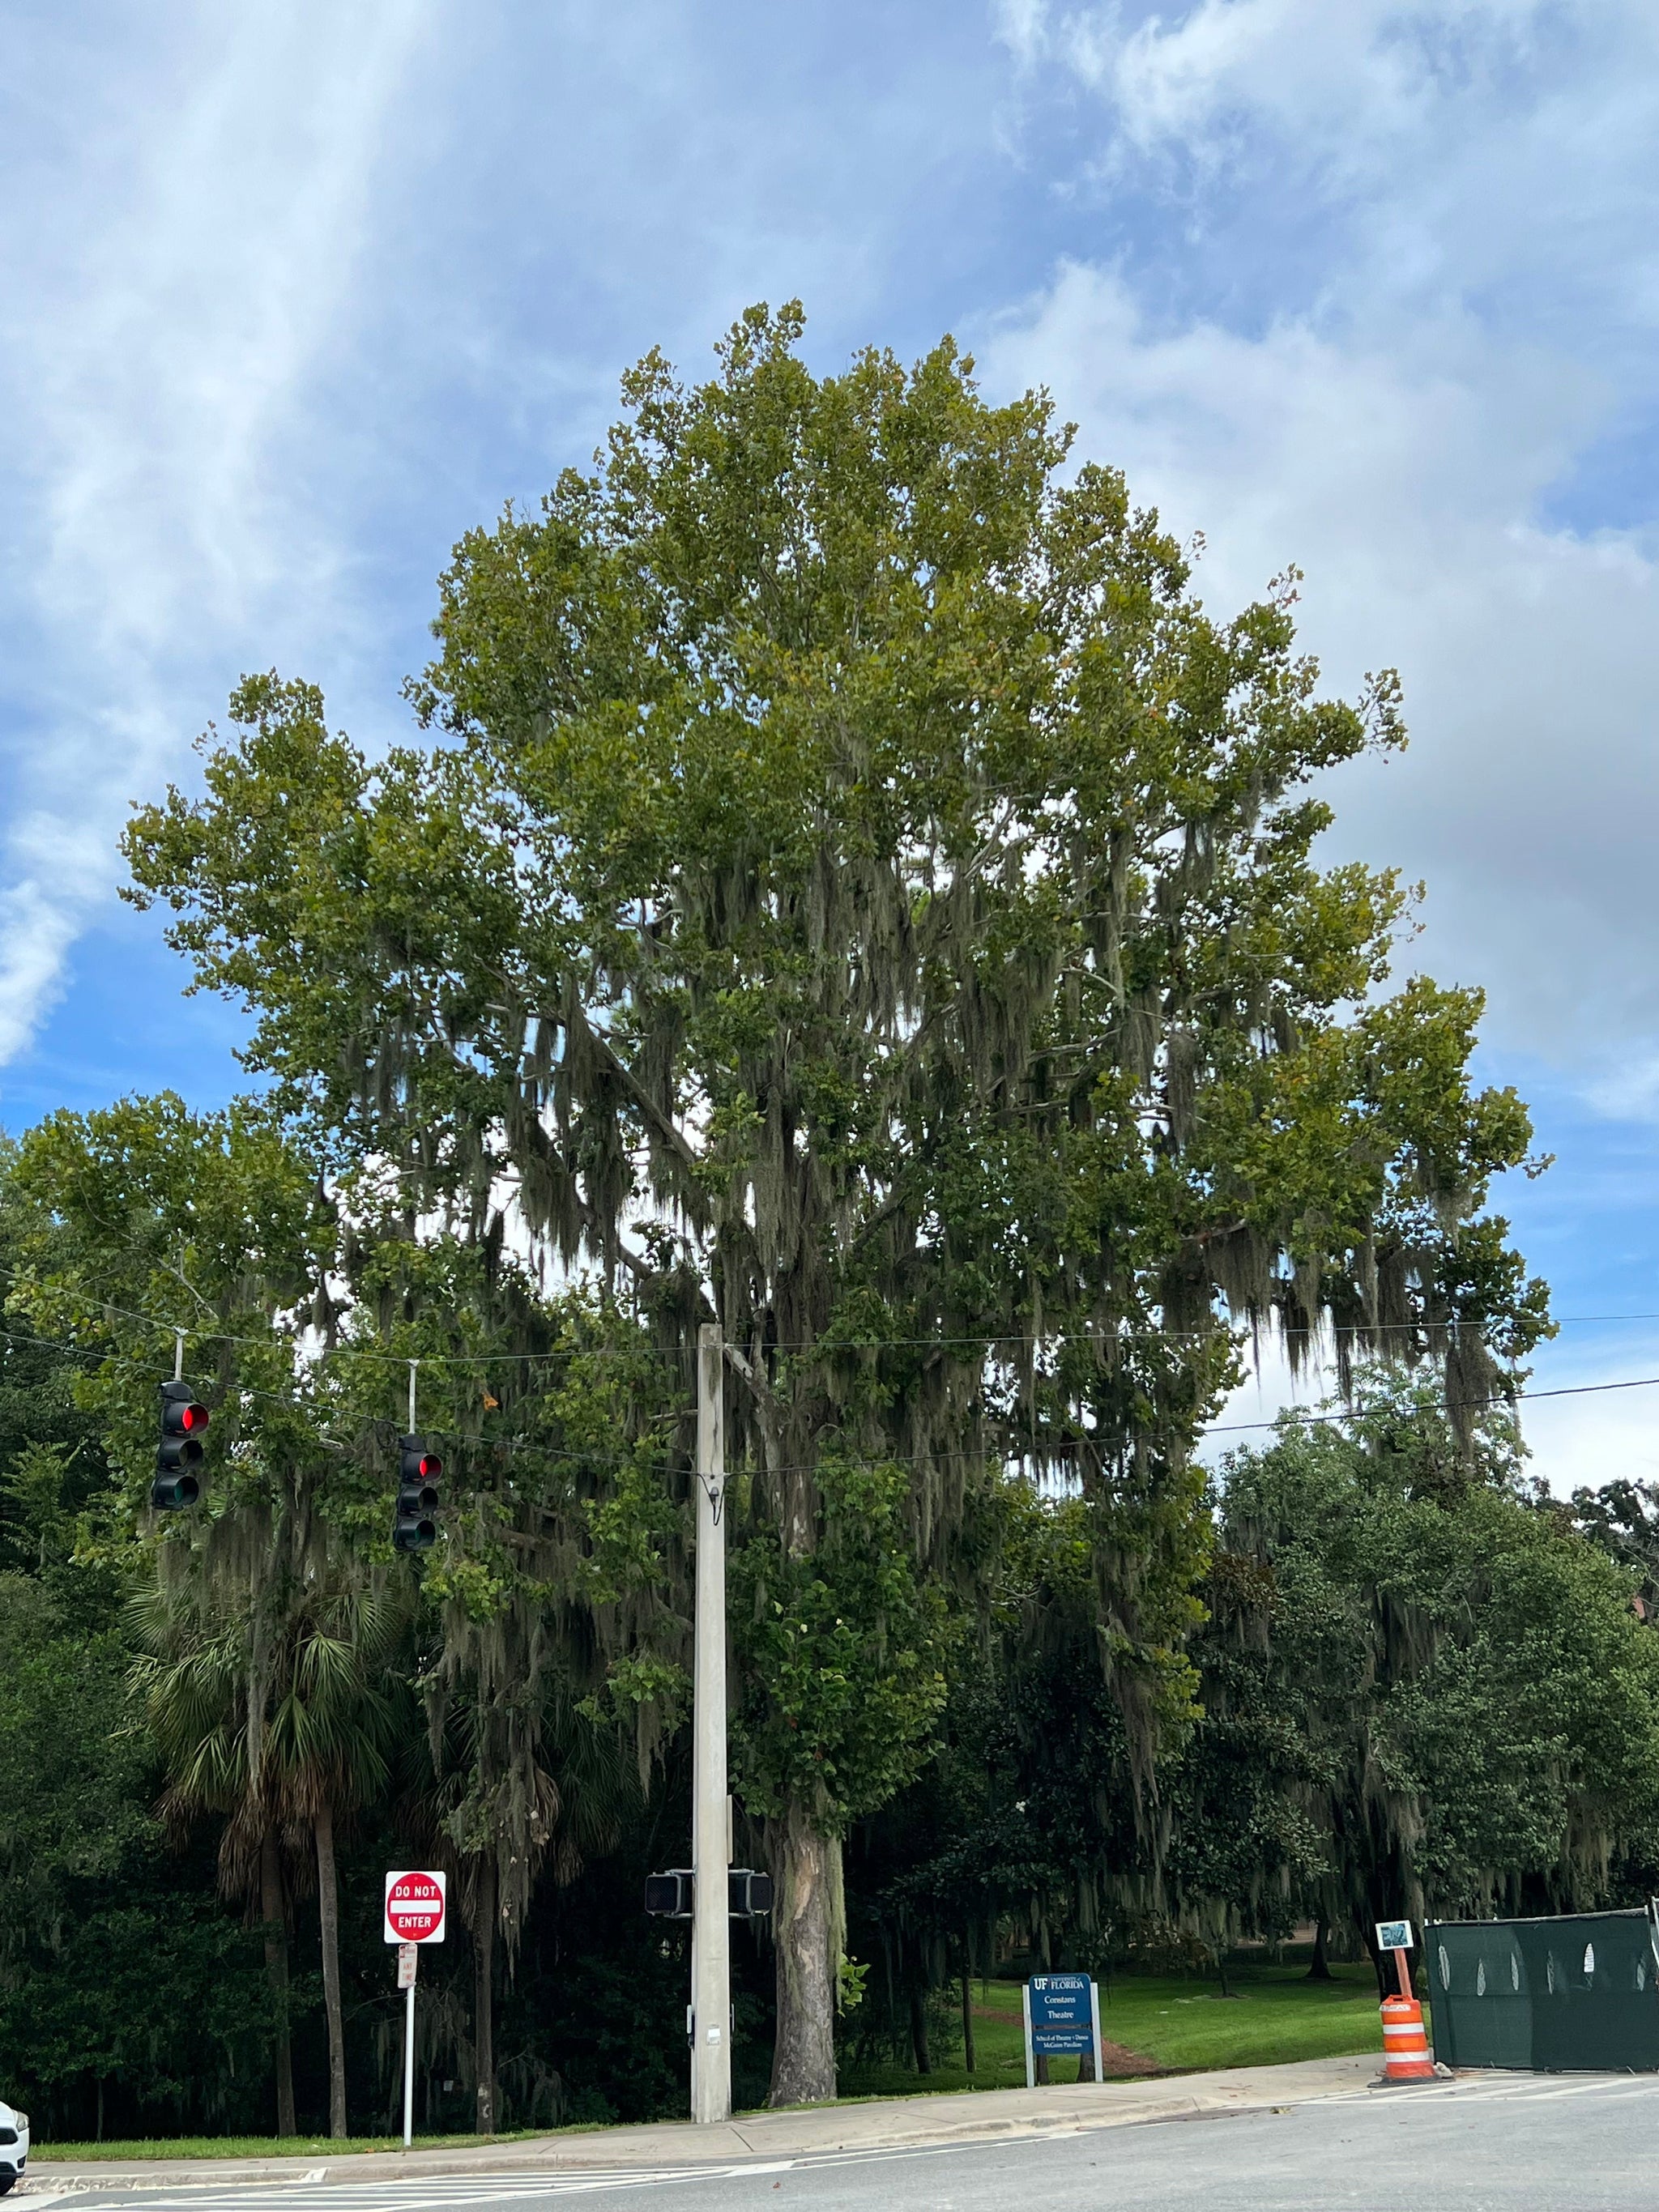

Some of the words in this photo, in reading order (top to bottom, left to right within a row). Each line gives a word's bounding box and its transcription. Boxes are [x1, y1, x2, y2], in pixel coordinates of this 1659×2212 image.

[395, 1886, 410, 1897] DO
[415, 1886, 437, 1897] NOT
[398, 1916, 431, 1928] ENTER
[1034, 1977, 1048, 1990] UF
[1051, 1981, 1085, 1990] FLORIDA
[1044, 1996, 1077, 2004] Constans
[1047, 2010, 1074, 2019] Theatre
